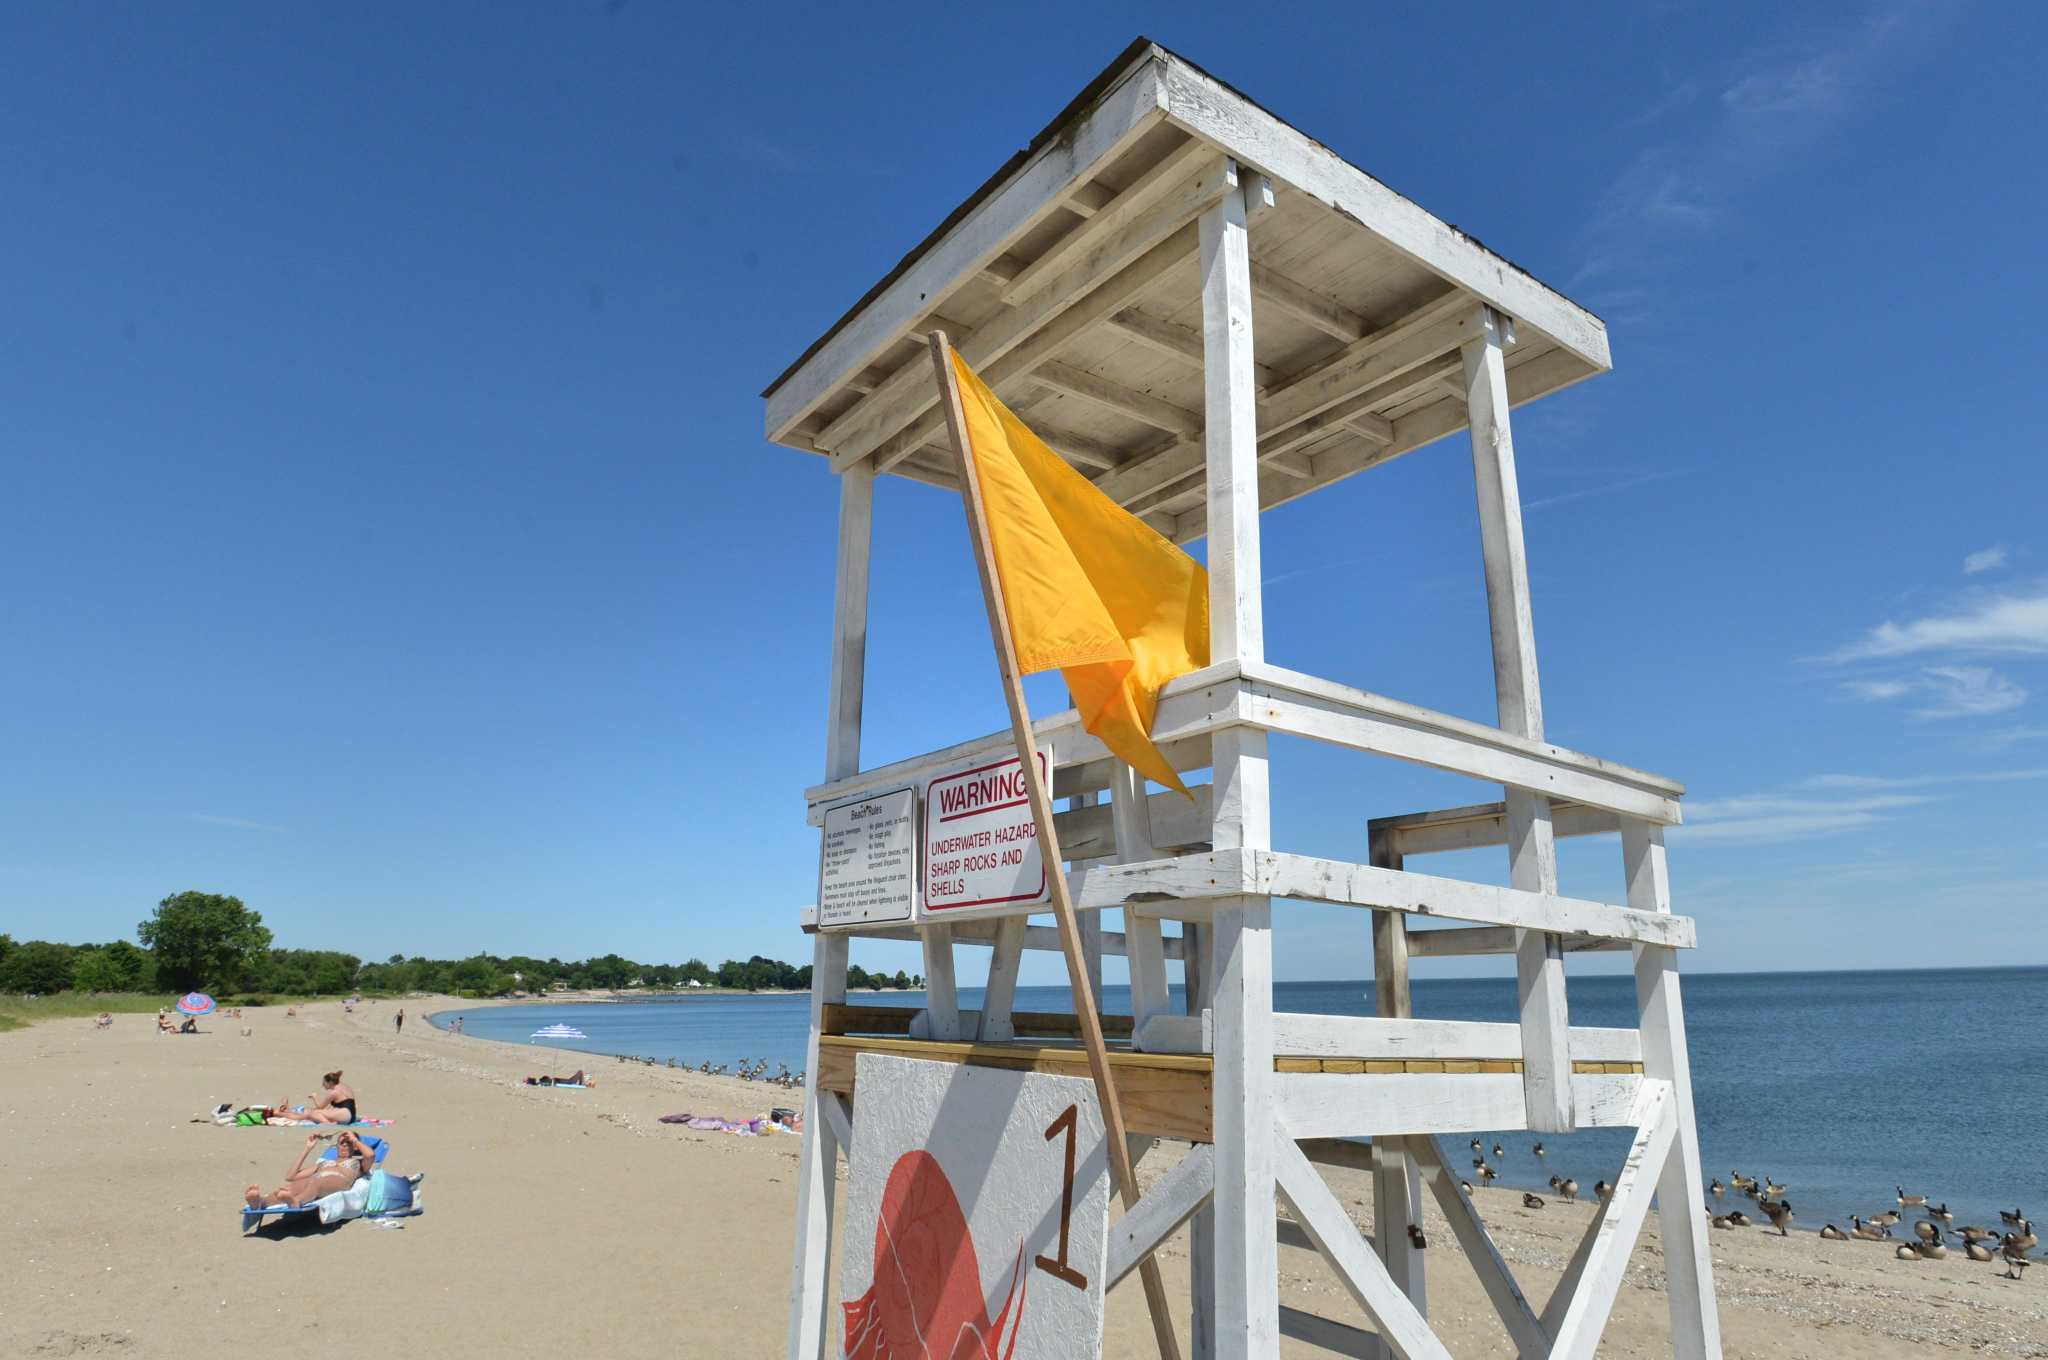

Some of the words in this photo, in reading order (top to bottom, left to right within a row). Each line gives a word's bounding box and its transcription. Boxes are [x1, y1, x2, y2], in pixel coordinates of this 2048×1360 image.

[940, 768, 1028, 814] WARNING
[931, 831, 991, 856] UNDERWATER
[931, 859, 961, 878] SHARP
[963, 852, 997, 872] ROCKS
[1001, 848, 1023, 867] AND
[931, 878, 965, 898] SHELLS
[1035, 1103, 1088, 1292] 1
